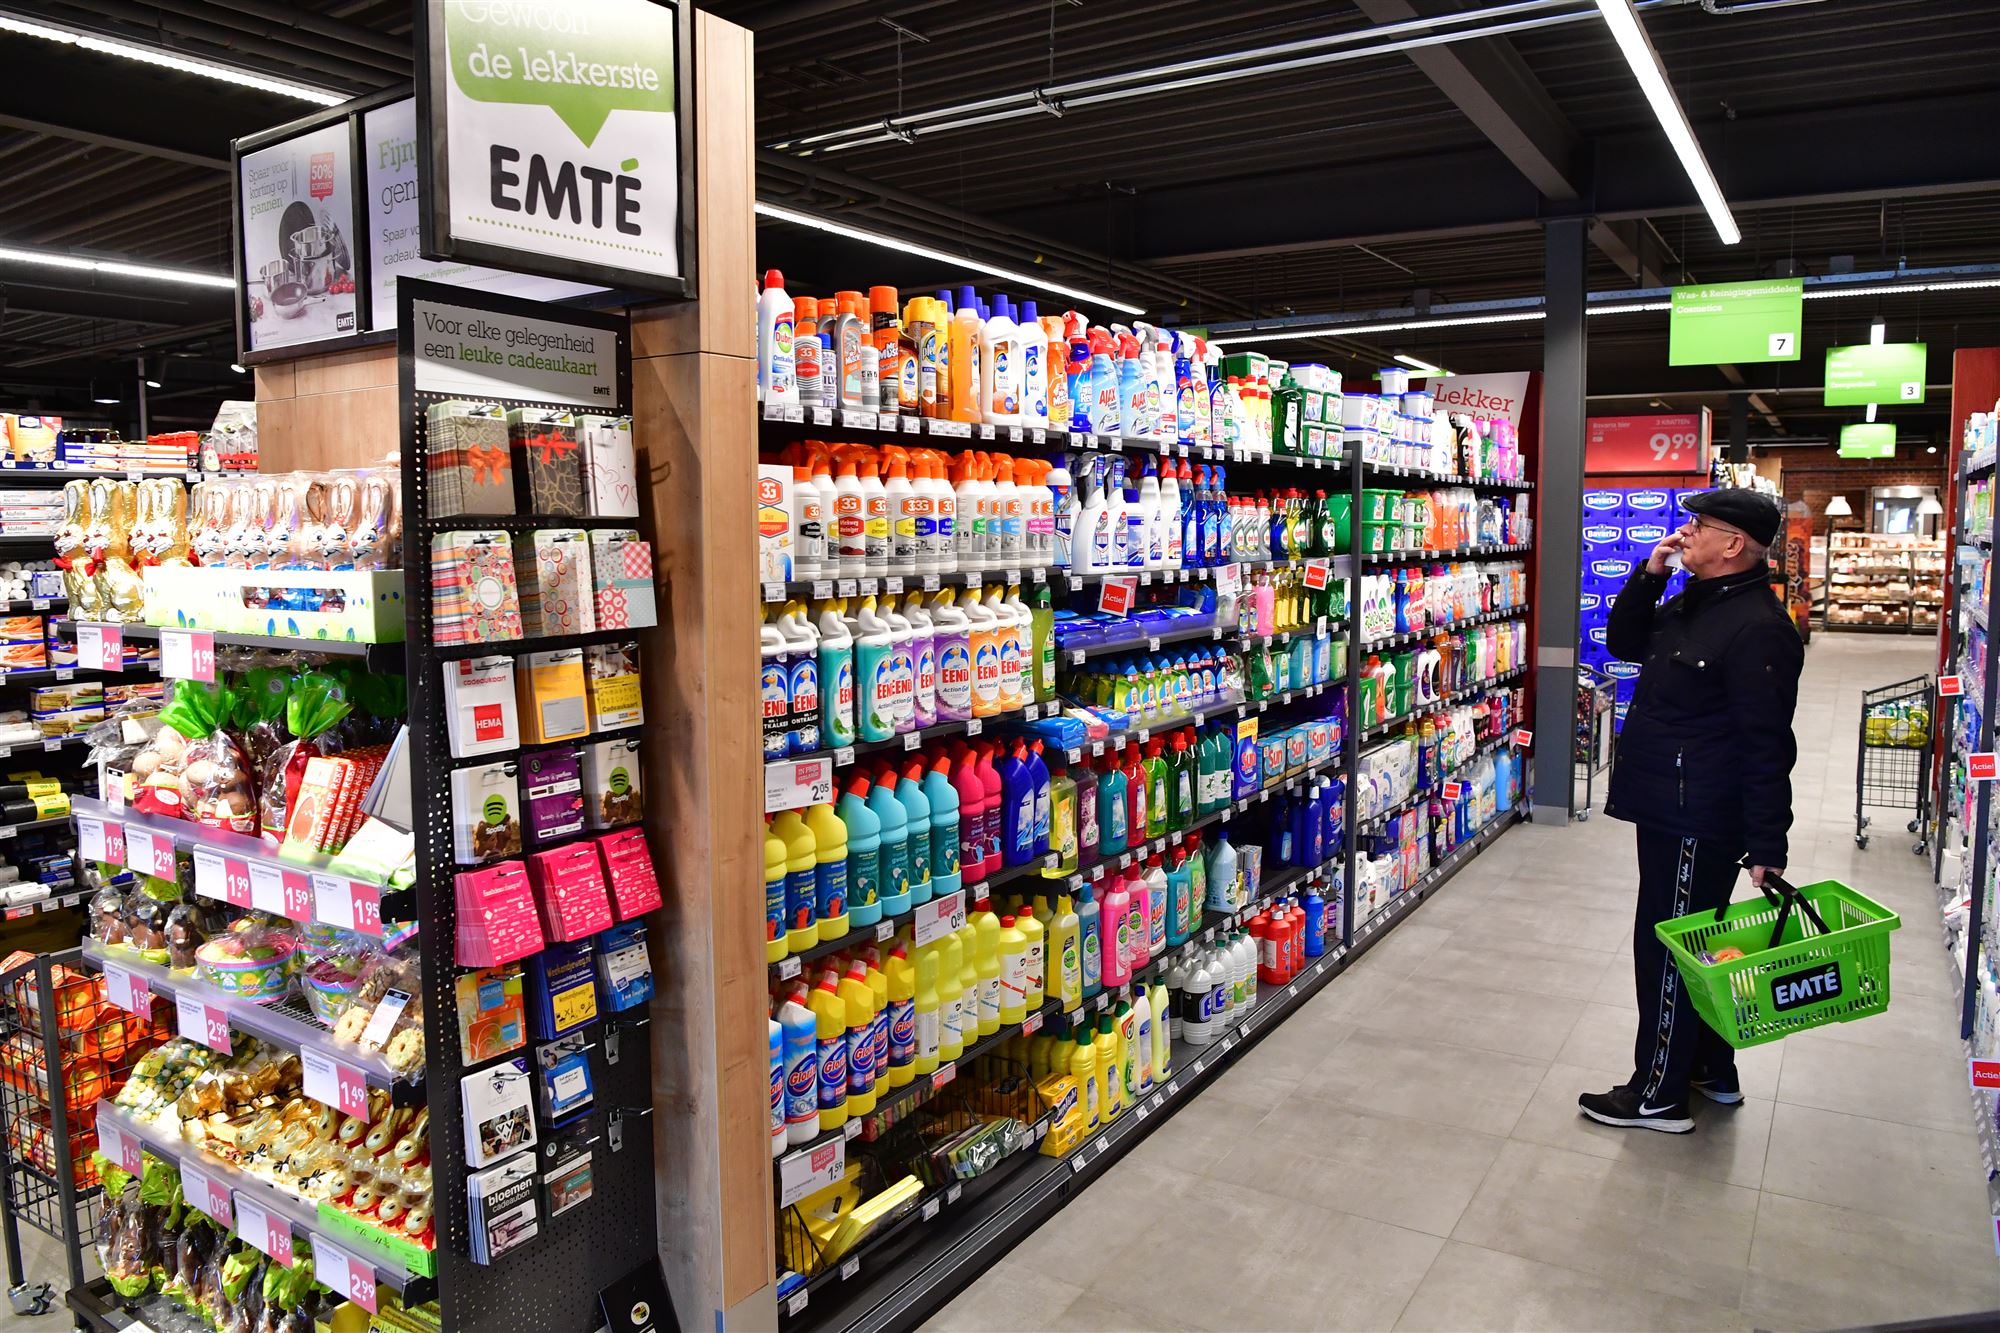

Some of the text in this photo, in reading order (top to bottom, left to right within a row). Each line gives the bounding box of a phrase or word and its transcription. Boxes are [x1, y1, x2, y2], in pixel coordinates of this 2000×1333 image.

[459, 0, 590, 35] Gewoon
[468, 43, 660, 91] de lekkerste
[248, 161, 289, 185] Spaar voor
[311, 165, 333, 180] 50%
[249, 180, 288, 200] korting op
[381, 179, 419, 214] gen
[490, 144, 642, 236] EMTÉ
[250, 196, 284, 220] pannen
[383, 226, 420, 247] Spaar vo
[383, 245, 421, 266] cadeau's
[1676, 284, 1801, 300] Was- & Reinigingsmiddelen
[1676, 303, 1723, 315] Cosmetica
[422, 311, 596, 354] Voor elke gelegenheid
[800, 347, 813, 357] 3G
[1776, 338, 1786, 350] 7
[424, 342, 598, 377] een leuke cadeaukaart
[593, 384, 610, 396] EMTÉ
[1098, 387, 1116, 406] AJAX
[1434, 383, 1515, 413] Lekker
[1906, 385, 1914, 396] 3
[1661, 417, 1691, 426] KRATTEN
[1649, 432, 1697, 461] 9.99
[761, 482, 776, 500] 3G
[1587, 495, 1618, 506] Bavaria
[1631, 495, 1663, 505] Bavaria
[810, 506, 820, 517] 3G
[841, 497, 857, 510] 3G
[915, 499, 929, 511] 3G
[1587, 529, 1617, 538] Bavaria
[1631, 528, 1662, 538] Bavaria
[1596, 562, 1627, 573] Bavaria
[1105, 592, 1126, 603] Actie!
[1580, 596, 1596, 605] aria
[103, 641, 120, 663] 2.49
[193, 650, 213, 673] 1.99
[942, 668, 969, 684] EEND
[977, 665, 999, 681] EEND
[1001, 660, 1021, 675] EEND
[1607, 665, 1639, 676] Bavaria
[463, 674, 507, 687] cadeaukaart
[920, 673, 934, 690] EEN
[942, 686, 962, 694] Action
[977, 682, 992, 690] Action
[839, 686, 853, 704] EEN
[877, 683, 893, 700] EEN
[602, 701, 639, 713] Cadeaukaart
[763, 700, 788, 717] END
[794, 693, 818, 714] EEND
[475, 718, 502, 729] HEMA
[1330, 724, 1341, 741] un
[1291, 737, 1305, 757] Sun
[1311, 729, 1326, 748] Sun
[1241, 751, 1257, 771] Sun
[1268, 749, 1283, 769] Sun
[1971, 762, 1995, 771] Actie!
[330, 765, 345, 790] REEP
[343, 763, 357, 789] REEP
[354, 761, 366, 786] REEP
[811, 783, 830, 802] 2.05
[106, 834, 123, 857] 1.99
[154, 849, 174, 873] 2.99
[227, 874, 249, 899] 1.99
[285, 887, 308, 912] 1.59
[1176, 893, 1190, 912] AJAX
[354, 899, 380, 926] 1.95
[950, 911, 964, 929] 0.89
[1774, 965, 1839, 1005] EMTÉ
[132, 991, 149, 1010] 1.59
[207, 1022, 228, 1044] 2.99
[1974, 1069, 2000, 1080] Actie!
[340, 1080, 365, 1108] 1.49
[827, 1161, 843, 1181] 1.59
[488, 1178, 533, 1207] bloemen
[492, 1189, 530, 1213] cadeaubon
[210, 1191, 230, 1218] 0.99
[269, 1228, 291, 1255] 1.59
[351, 1273, 375, 1302] 2.99
